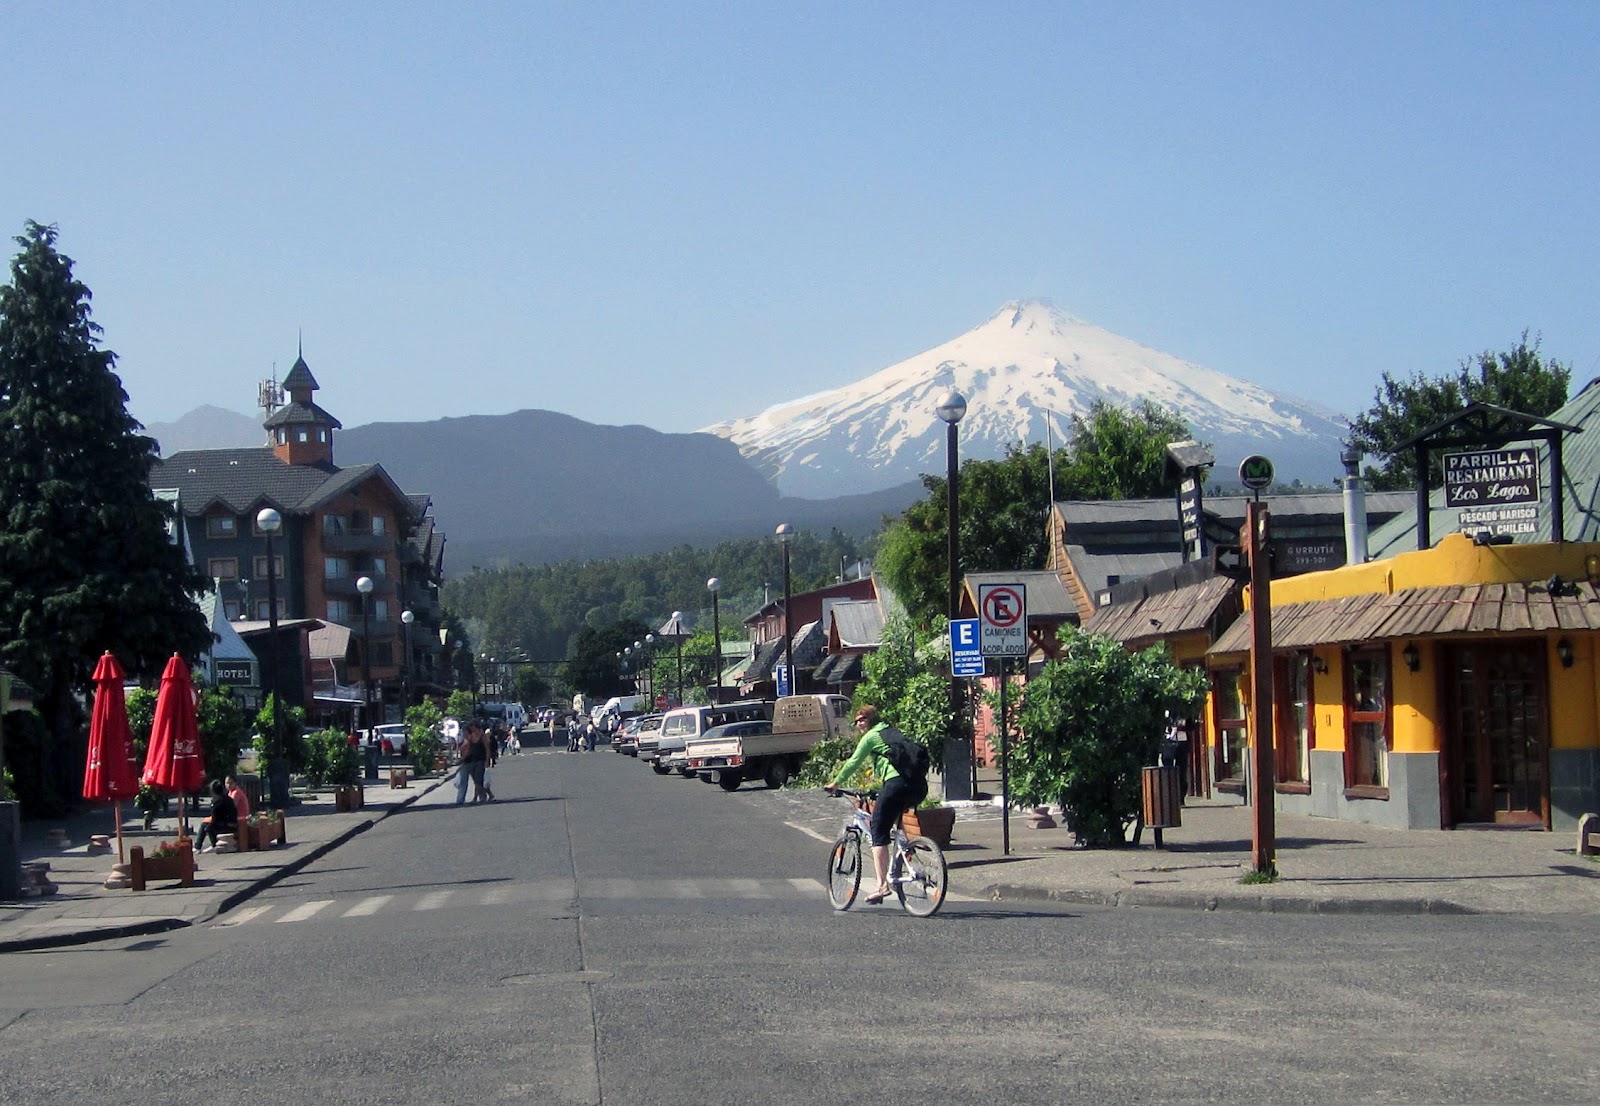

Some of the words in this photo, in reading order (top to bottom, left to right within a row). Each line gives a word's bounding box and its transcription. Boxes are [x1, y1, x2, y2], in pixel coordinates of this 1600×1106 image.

[1450, 452, 1530, 468] PARRILLA
[1447, 464, 1535, 484] RESTAURANT
[1451, 485, 1479, 501] Los
[1486, 483, 1530, 501] Lagos
[1497, 522, 1536, 535] CHILENA
[960, 624, 973, 645] E
[984, 628, 1021, 637] CAMIONES
[1001, 637, 1006, 645] Y
[982, 645, 1024, 653] ACOPLADOS
[216, 669, 250, 678] HOTEL
